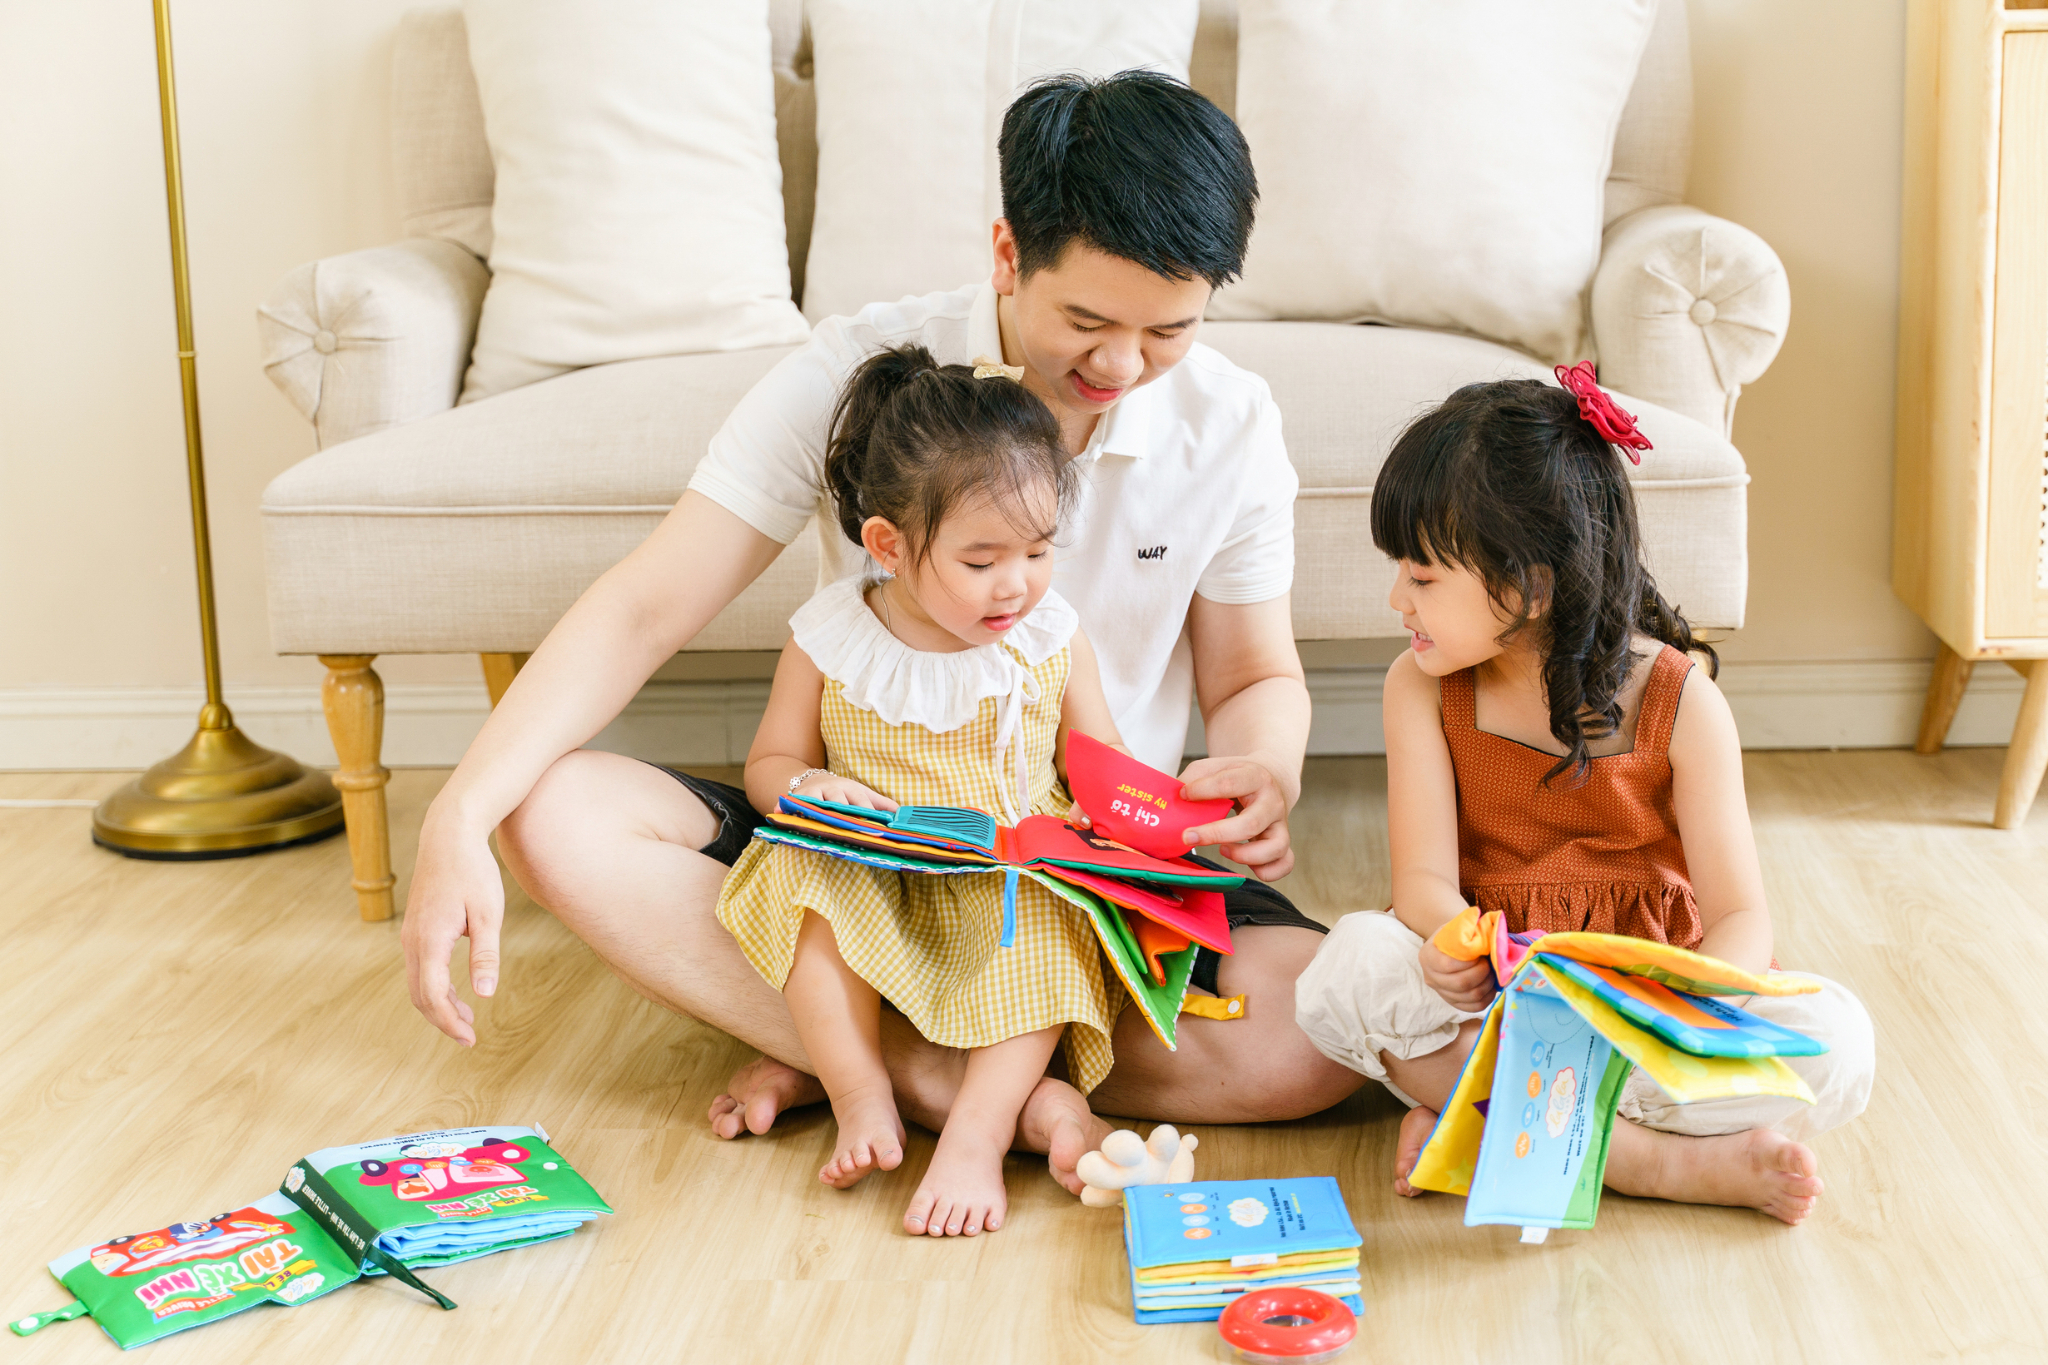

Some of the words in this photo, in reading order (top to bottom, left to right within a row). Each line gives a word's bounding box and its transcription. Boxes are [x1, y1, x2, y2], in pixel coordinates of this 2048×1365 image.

[1137, 545, 1168, 561] WAY
[1116, 783, 1154, 802] sister
[1153, 797, 1168, 810] My
[1134, 806, 1160, 827] Chị
[315, 1196, 330, 1215] LITTLE
[242, 1241, 299, 1277] TÀI
[139, 1271, 196, 1308] NHÍ
[157, 1301, 196, 1316] DRIVER
